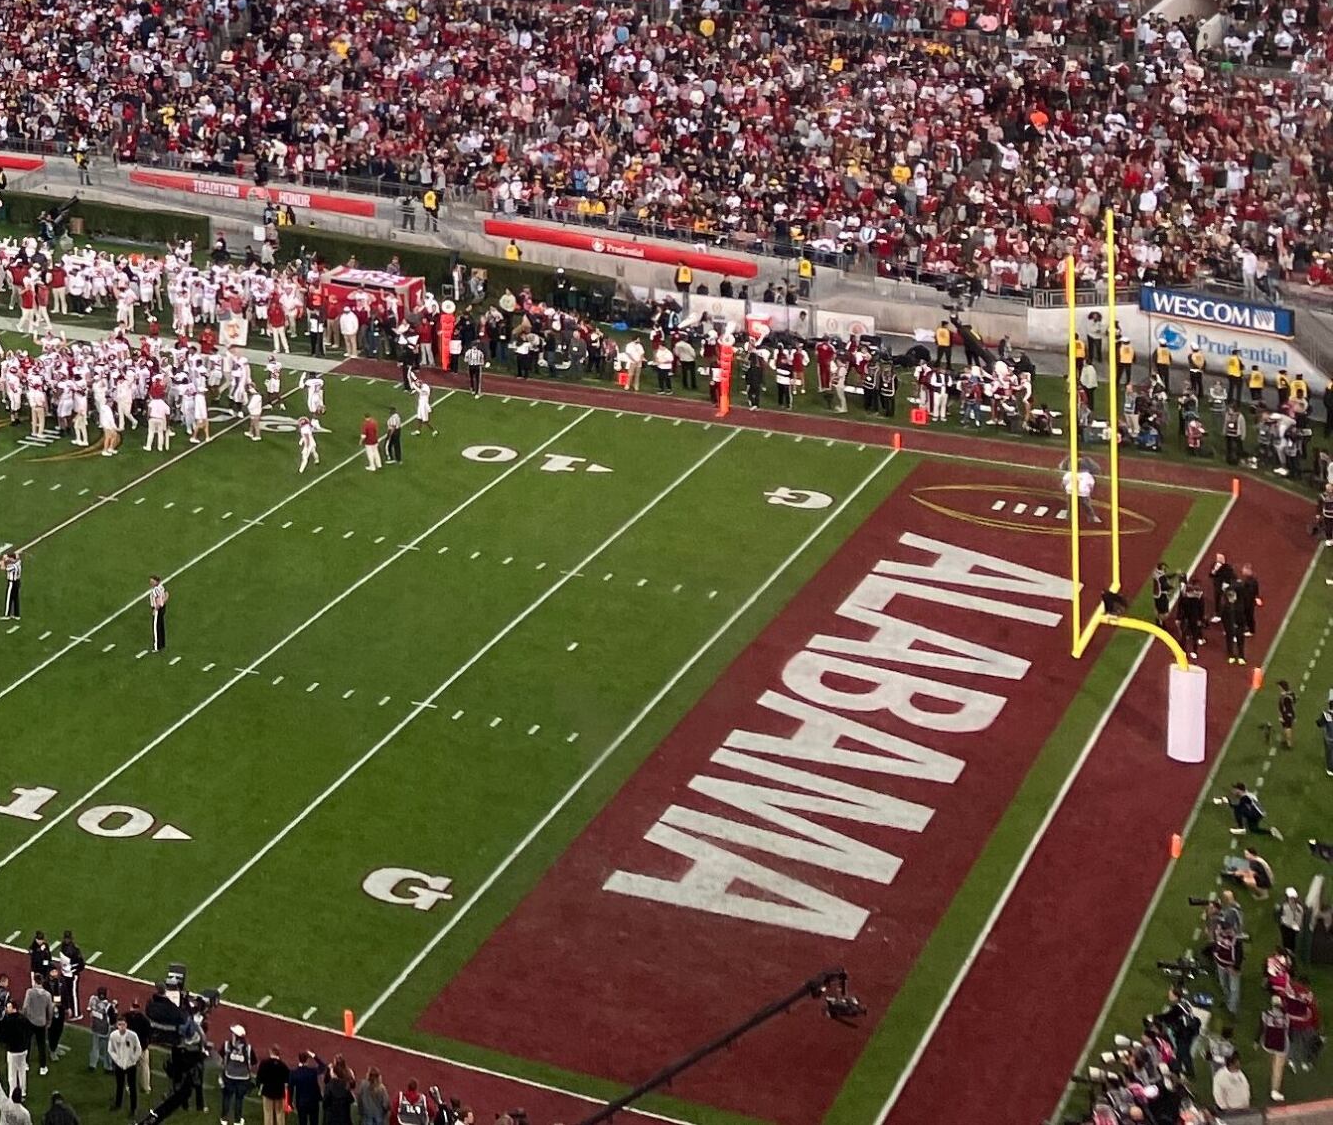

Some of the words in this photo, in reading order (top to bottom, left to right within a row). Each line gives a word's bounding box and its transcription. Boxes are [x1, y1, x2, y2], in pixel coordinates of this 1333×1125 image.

[193, 180, 240, 198] TRADITION
[278, 192, 311, 208] HONOR
[1152, 291, 1251, 328] WESCOM
[461, 445, 587, 473] 10
[763, 485, 834, 509] G
[601, 531, 1084, 941] ALABAMA
[361, 866, 453, 912] G
